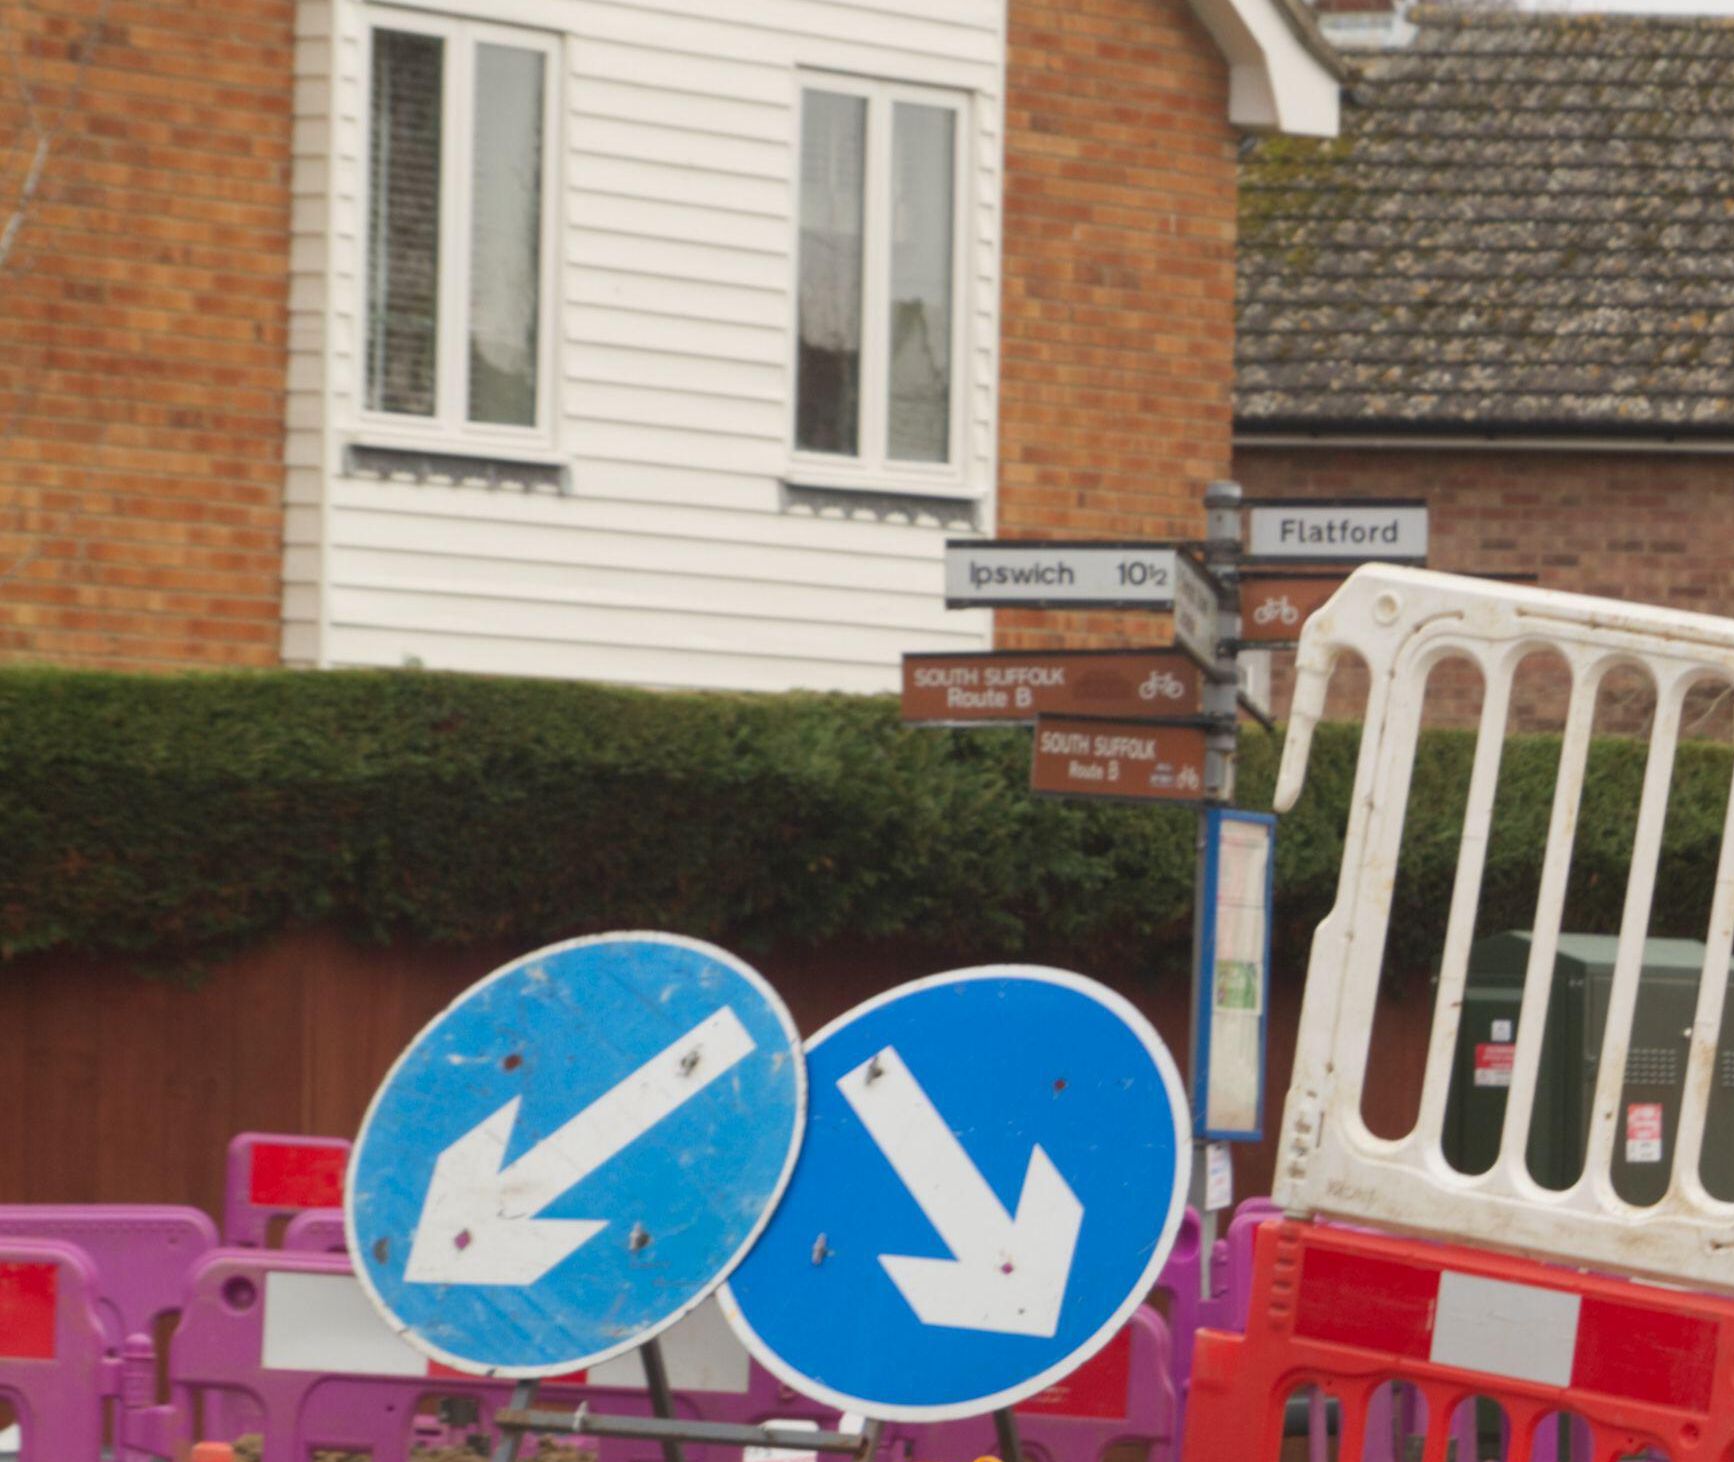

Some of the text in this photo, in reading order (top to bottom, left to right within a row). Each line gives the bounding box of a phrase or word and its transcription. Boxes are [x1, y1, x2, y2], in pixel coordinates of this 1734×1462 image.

[1280, 518, 1399, 544] Flatford
[969, 561, 1075, 589] Ipswich
[914, 666, 1066, 687] SOUTH SUFFOLK
[947, 686, 1033, 709] Route B
[1040, 731, 1157, 761] SOUTH SUFFOLK
[1068, 759, 1104, 781] Route
